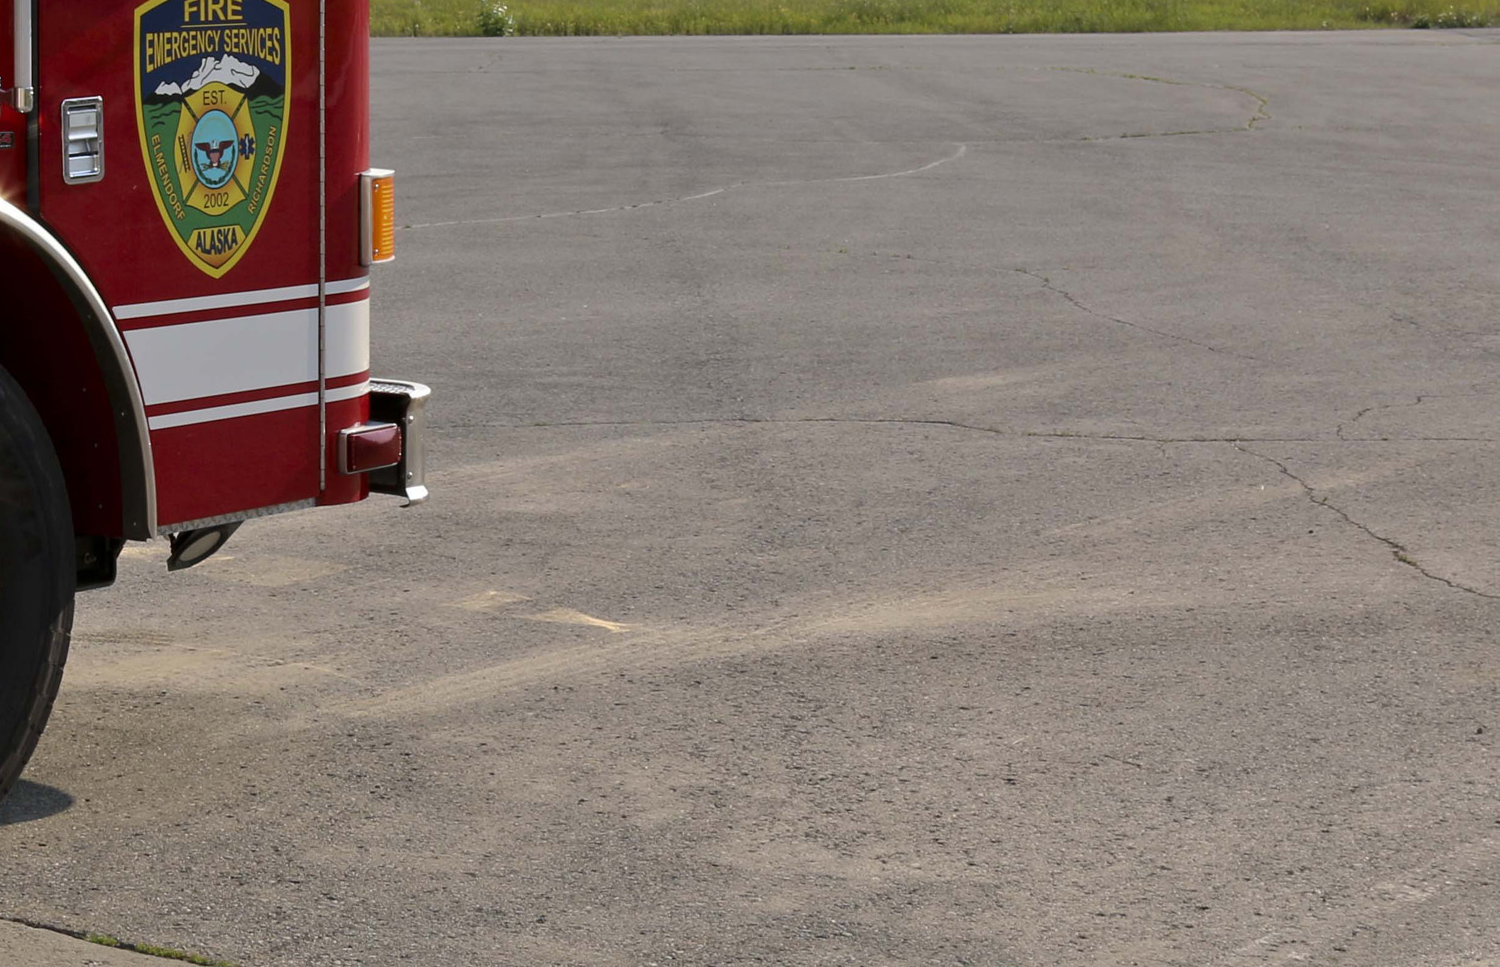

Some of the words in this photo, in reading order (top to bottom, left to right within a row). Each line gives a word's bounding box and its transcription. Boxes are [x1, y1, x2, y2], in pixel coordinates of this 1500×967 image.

[145, 29, 221, 74] EMERGENCY
[223, 27, 281, 66] SERVICES
[203, 90, 227, 106] EST.
[151, 134, 185, 220] ELMENDORF
[247, 125, 277, 215] RICHARDSON
[203, 192, 229, 209] 2002
[195, 227, 238, 255] ALASKA
